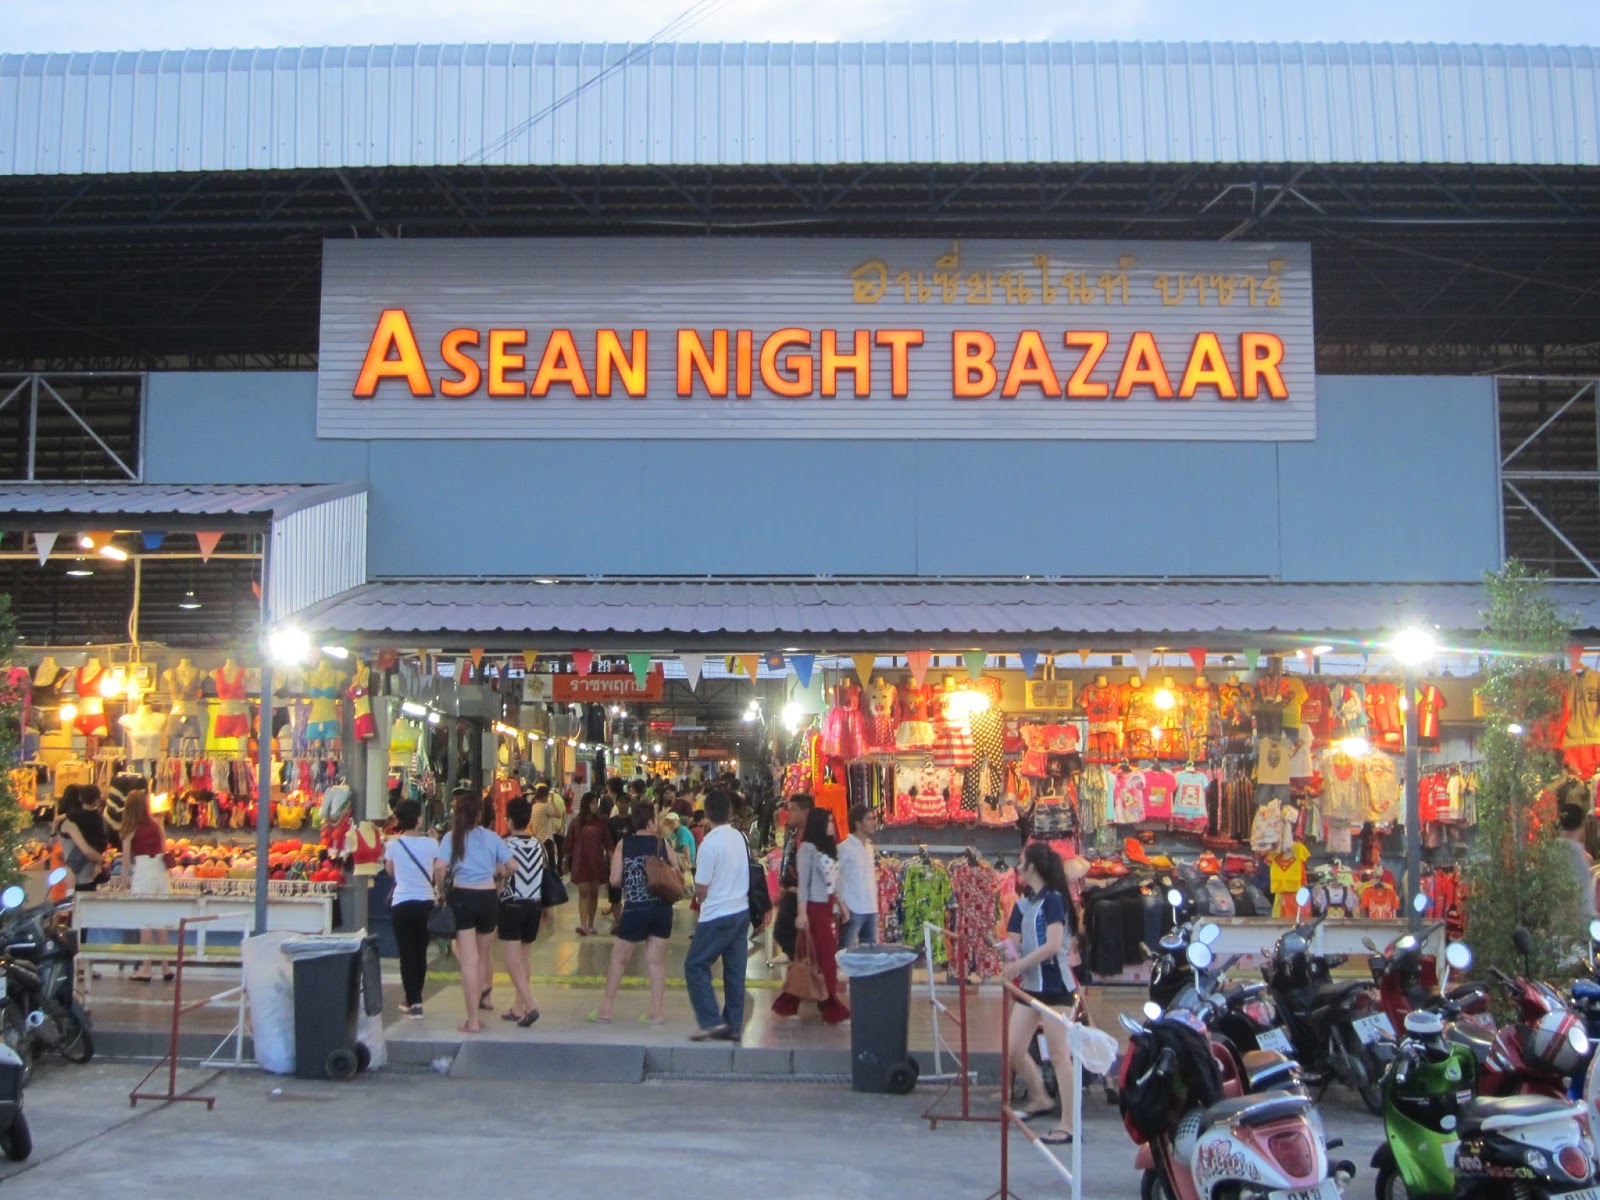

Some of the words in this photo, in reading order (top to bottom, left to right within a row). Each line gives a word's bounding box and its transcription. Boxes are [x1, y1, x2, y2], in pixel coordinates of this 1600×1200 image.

[353, 308, 648, 397] ASEAN
[677, 327, 924, 397] NIGHT
[953, 329, 1288, 399] BAZAAR
